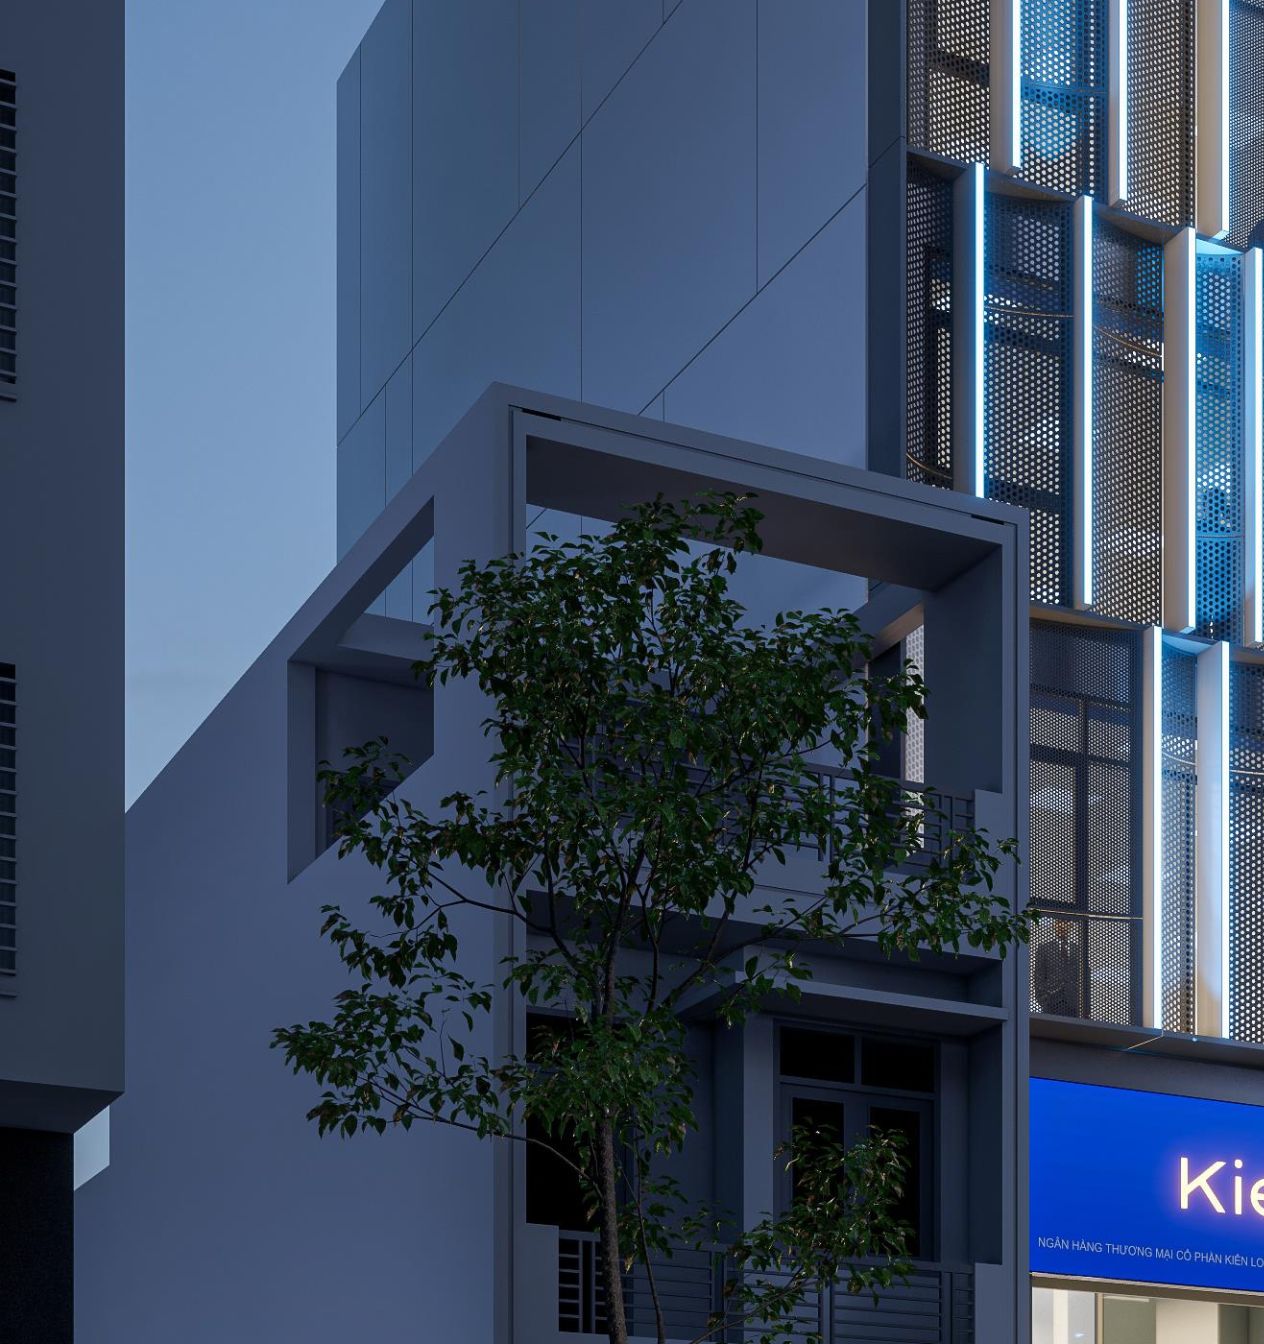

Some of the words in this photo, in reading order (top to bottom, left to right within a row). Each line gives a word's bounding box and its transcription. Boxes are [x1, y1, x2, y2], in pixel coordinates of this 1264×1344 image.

[1038, 1236, 1069, 1250] NGÂN
[1071, 1238, 1103, 1253] HÀNG
[1105, 1242, 1153, 1258] THƯƠNG
[1155, 1247, 1174, 1261] MẠI
[1224, 1253, 1248, 1266] KIÊN
